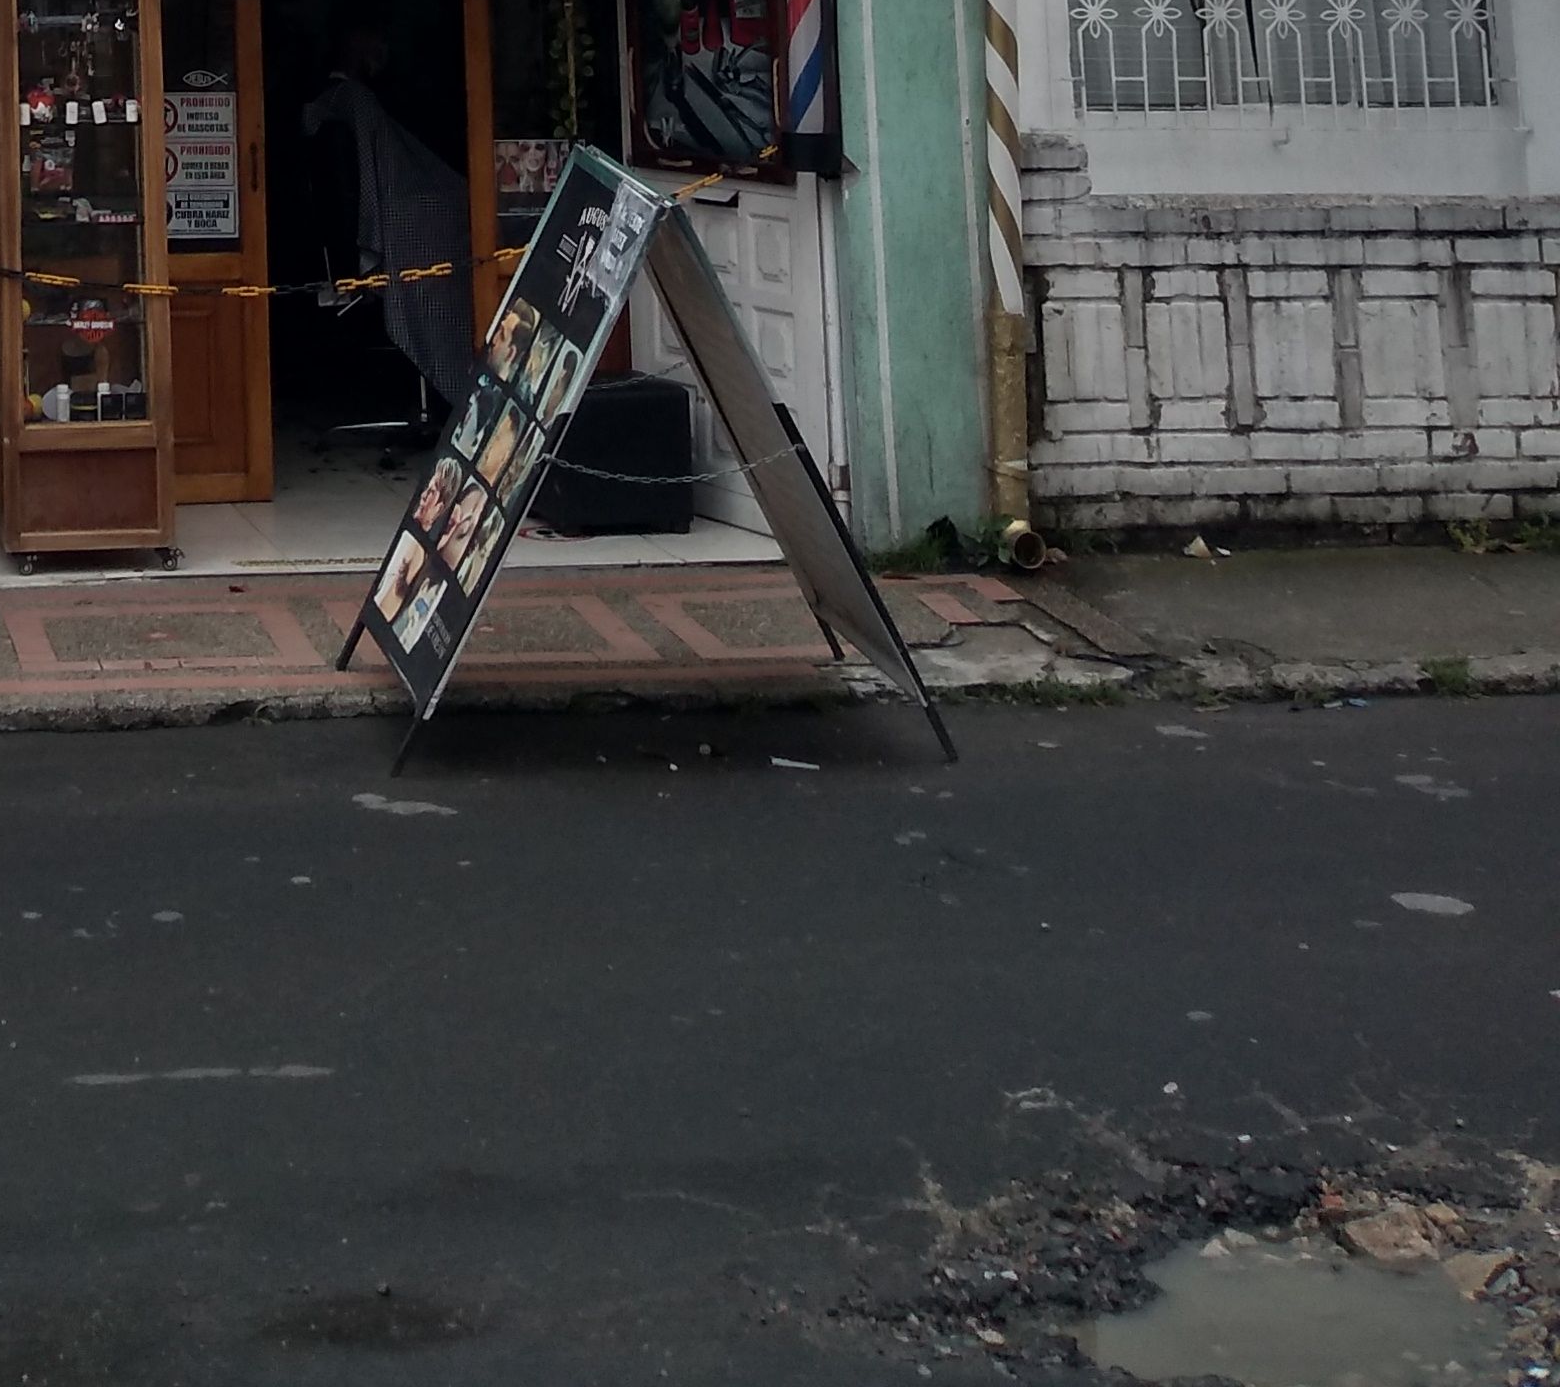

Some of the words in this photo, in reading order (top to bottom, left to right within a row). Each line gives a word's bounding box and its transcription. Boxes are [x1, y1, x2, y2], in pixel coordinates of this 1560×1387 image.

[180, 97, 230, 108] PROHIBIDO
[188, 123, 229, 133] MASCOTAS
[180, 146, 230, 156] PROHIBIDO
[194, 219, 218, 228] BOCA
[577, 206, 610, 232] AUGUS
